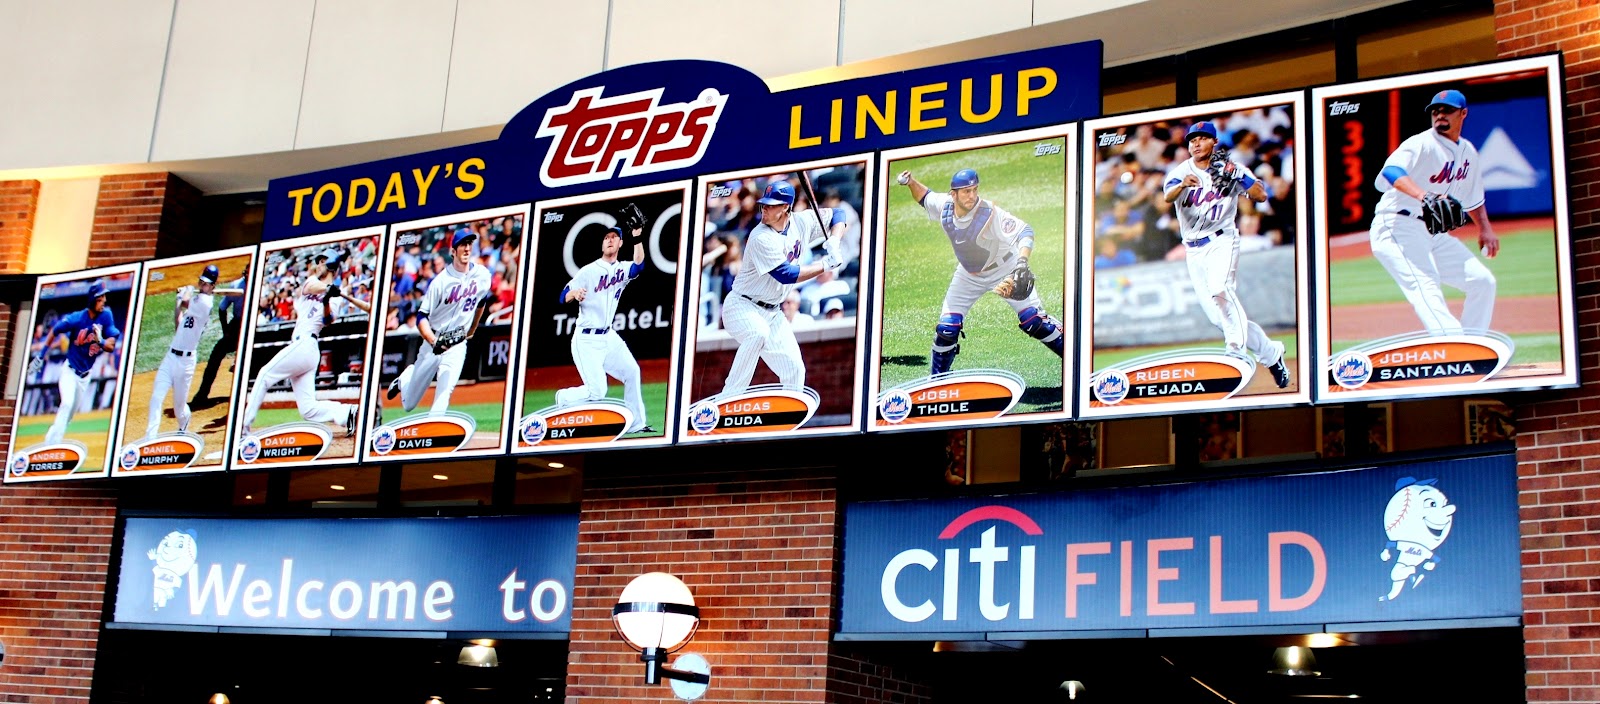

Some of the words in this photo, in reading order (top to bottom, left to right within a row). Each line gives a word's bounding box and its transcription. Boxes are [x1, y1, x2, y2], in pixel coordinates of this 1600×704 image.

[288, 157, 487, 226] TODAY'S
[788, 67, 1058, 149] LINEUP
[1429, 159, 1470, 184] Met
[1211, 204, 1224, 221] 11
[445, 279, 478, 305] Mets
[184, 316, 195, 329] 28
[1379, 349, 1446, 364] JOHAN
[1136, 368, 1196, 382] RUBEN
[1380, 362, 1475, 380] SANTANA
[918, 389, 959, 401] JOSH
[1136, 382, 1206, 396] TEJADA
[725, 402, 771, 413] LUCAS
[917, 402, 969, 415] THOLE
[551, 415, 594, 426] JASON
[724, 415, 763, 426] DUDA
[400, 428, 418, 437] IKE
[551, 428, 576, 438] BAY
[264, 436, 296, 446] DAVID
[398, 438, 433, 449] DAVIS
[143, 445, 176, 454] DANIEL
[263, 447, 302, 457] WRIGHT
[32, 452, 66, 461] ANDRES
[141, 455, 180, 465] MURPHY
[30, 462, 64, 471] TORRES
[1065, 531, 1328, 619] FIELD
[188, 558, 454, 621] Welcome
[500, 569, 567, 622] to
